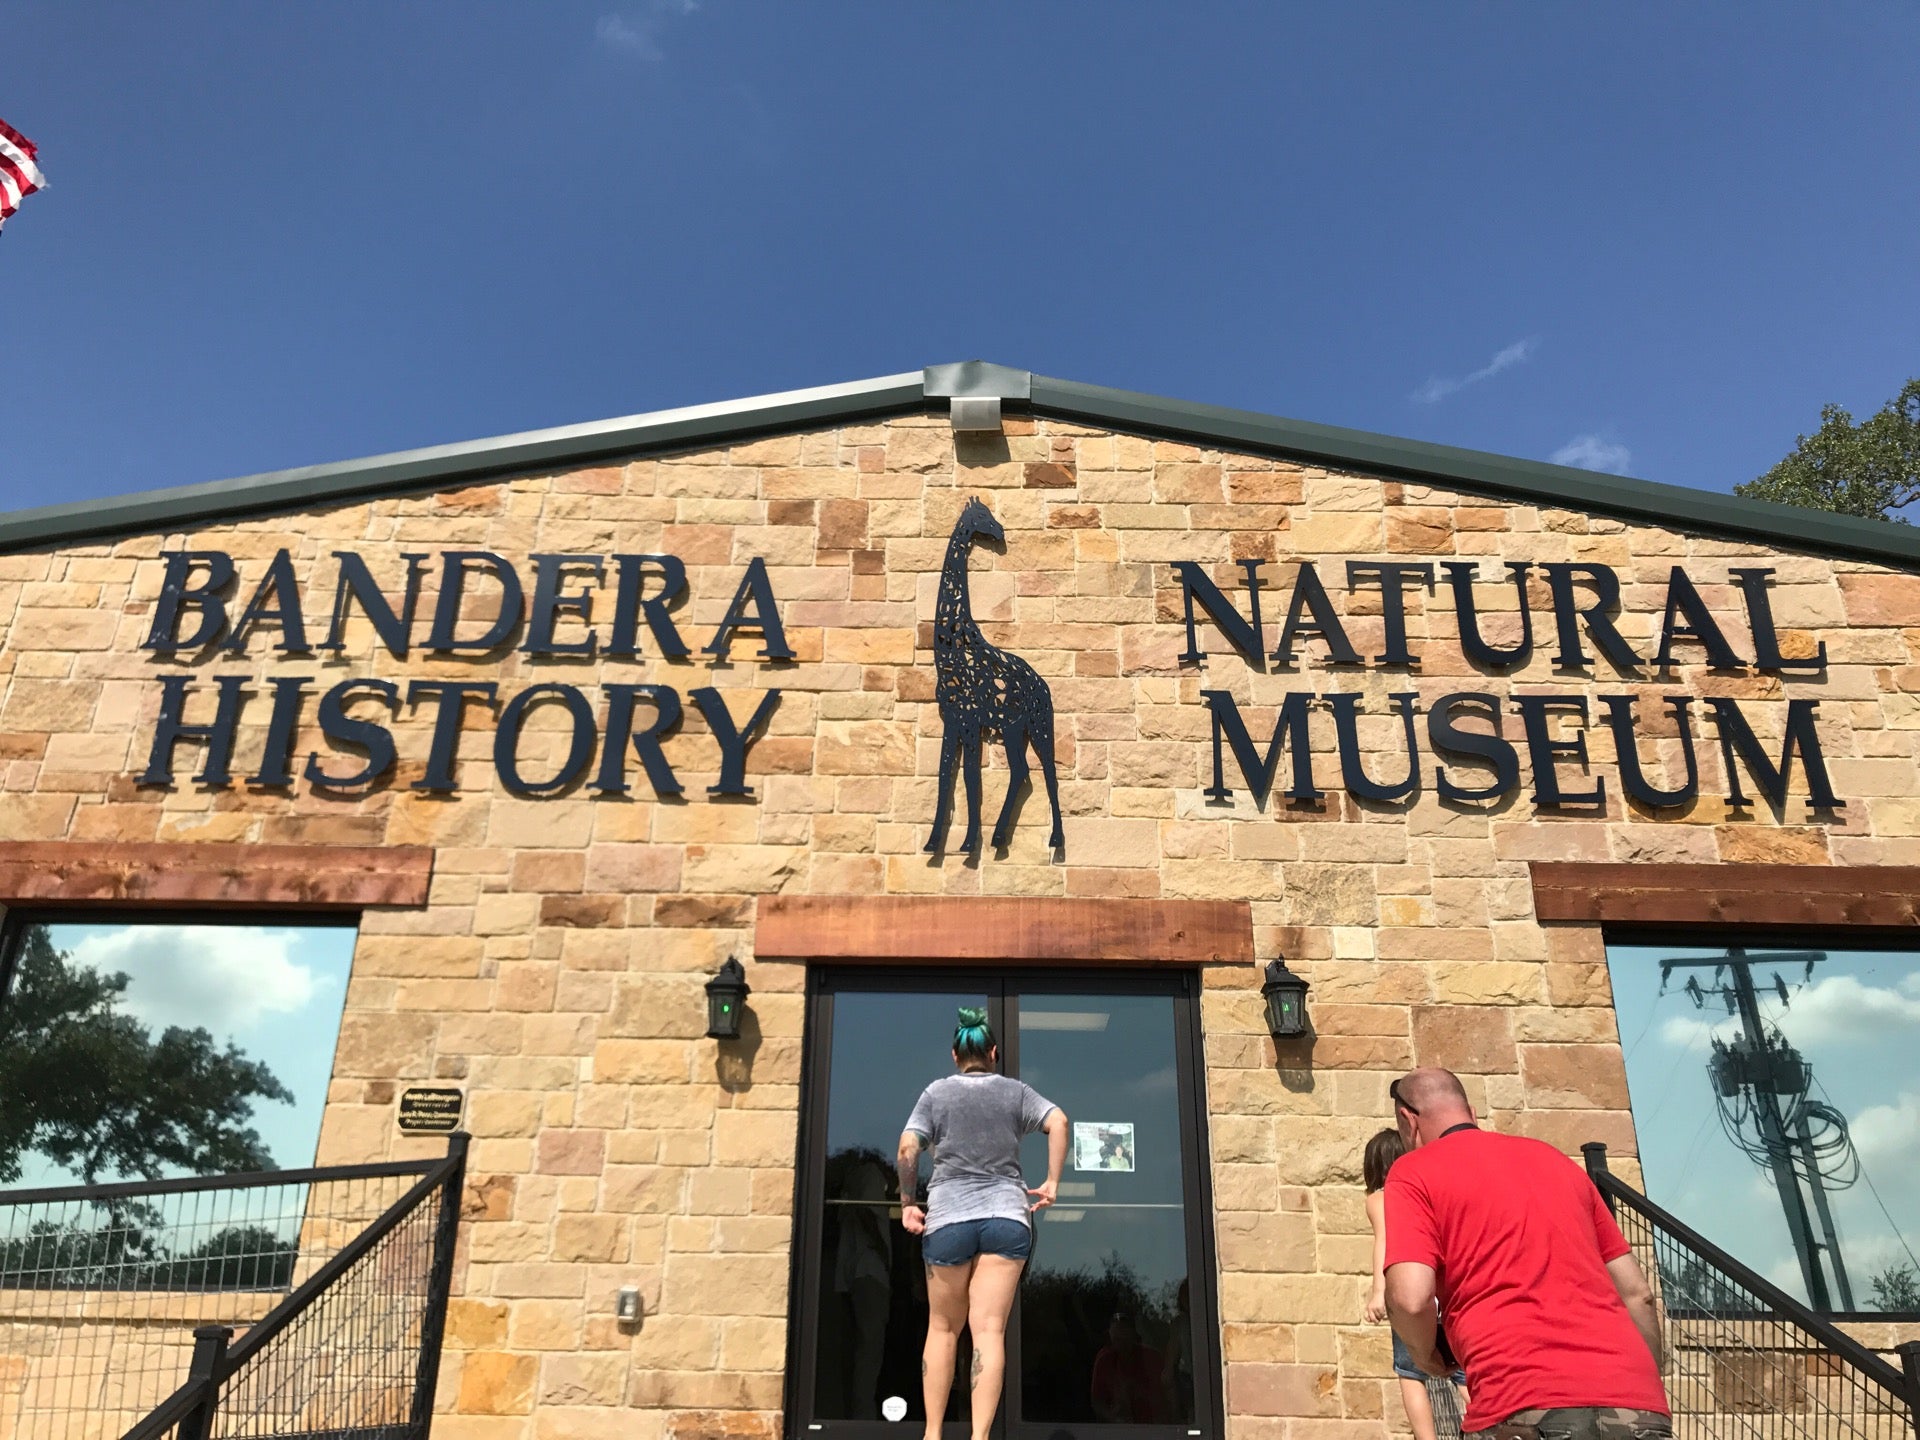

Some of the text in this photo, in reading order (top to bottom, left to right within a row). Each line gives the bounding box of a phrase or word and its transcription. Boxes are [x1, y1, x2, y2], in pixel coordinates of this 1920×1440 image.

[140, 549, 1827, 673] BANDERA NATURAL
[133, 675, 1846, 816] HISTORY MUSEUM
